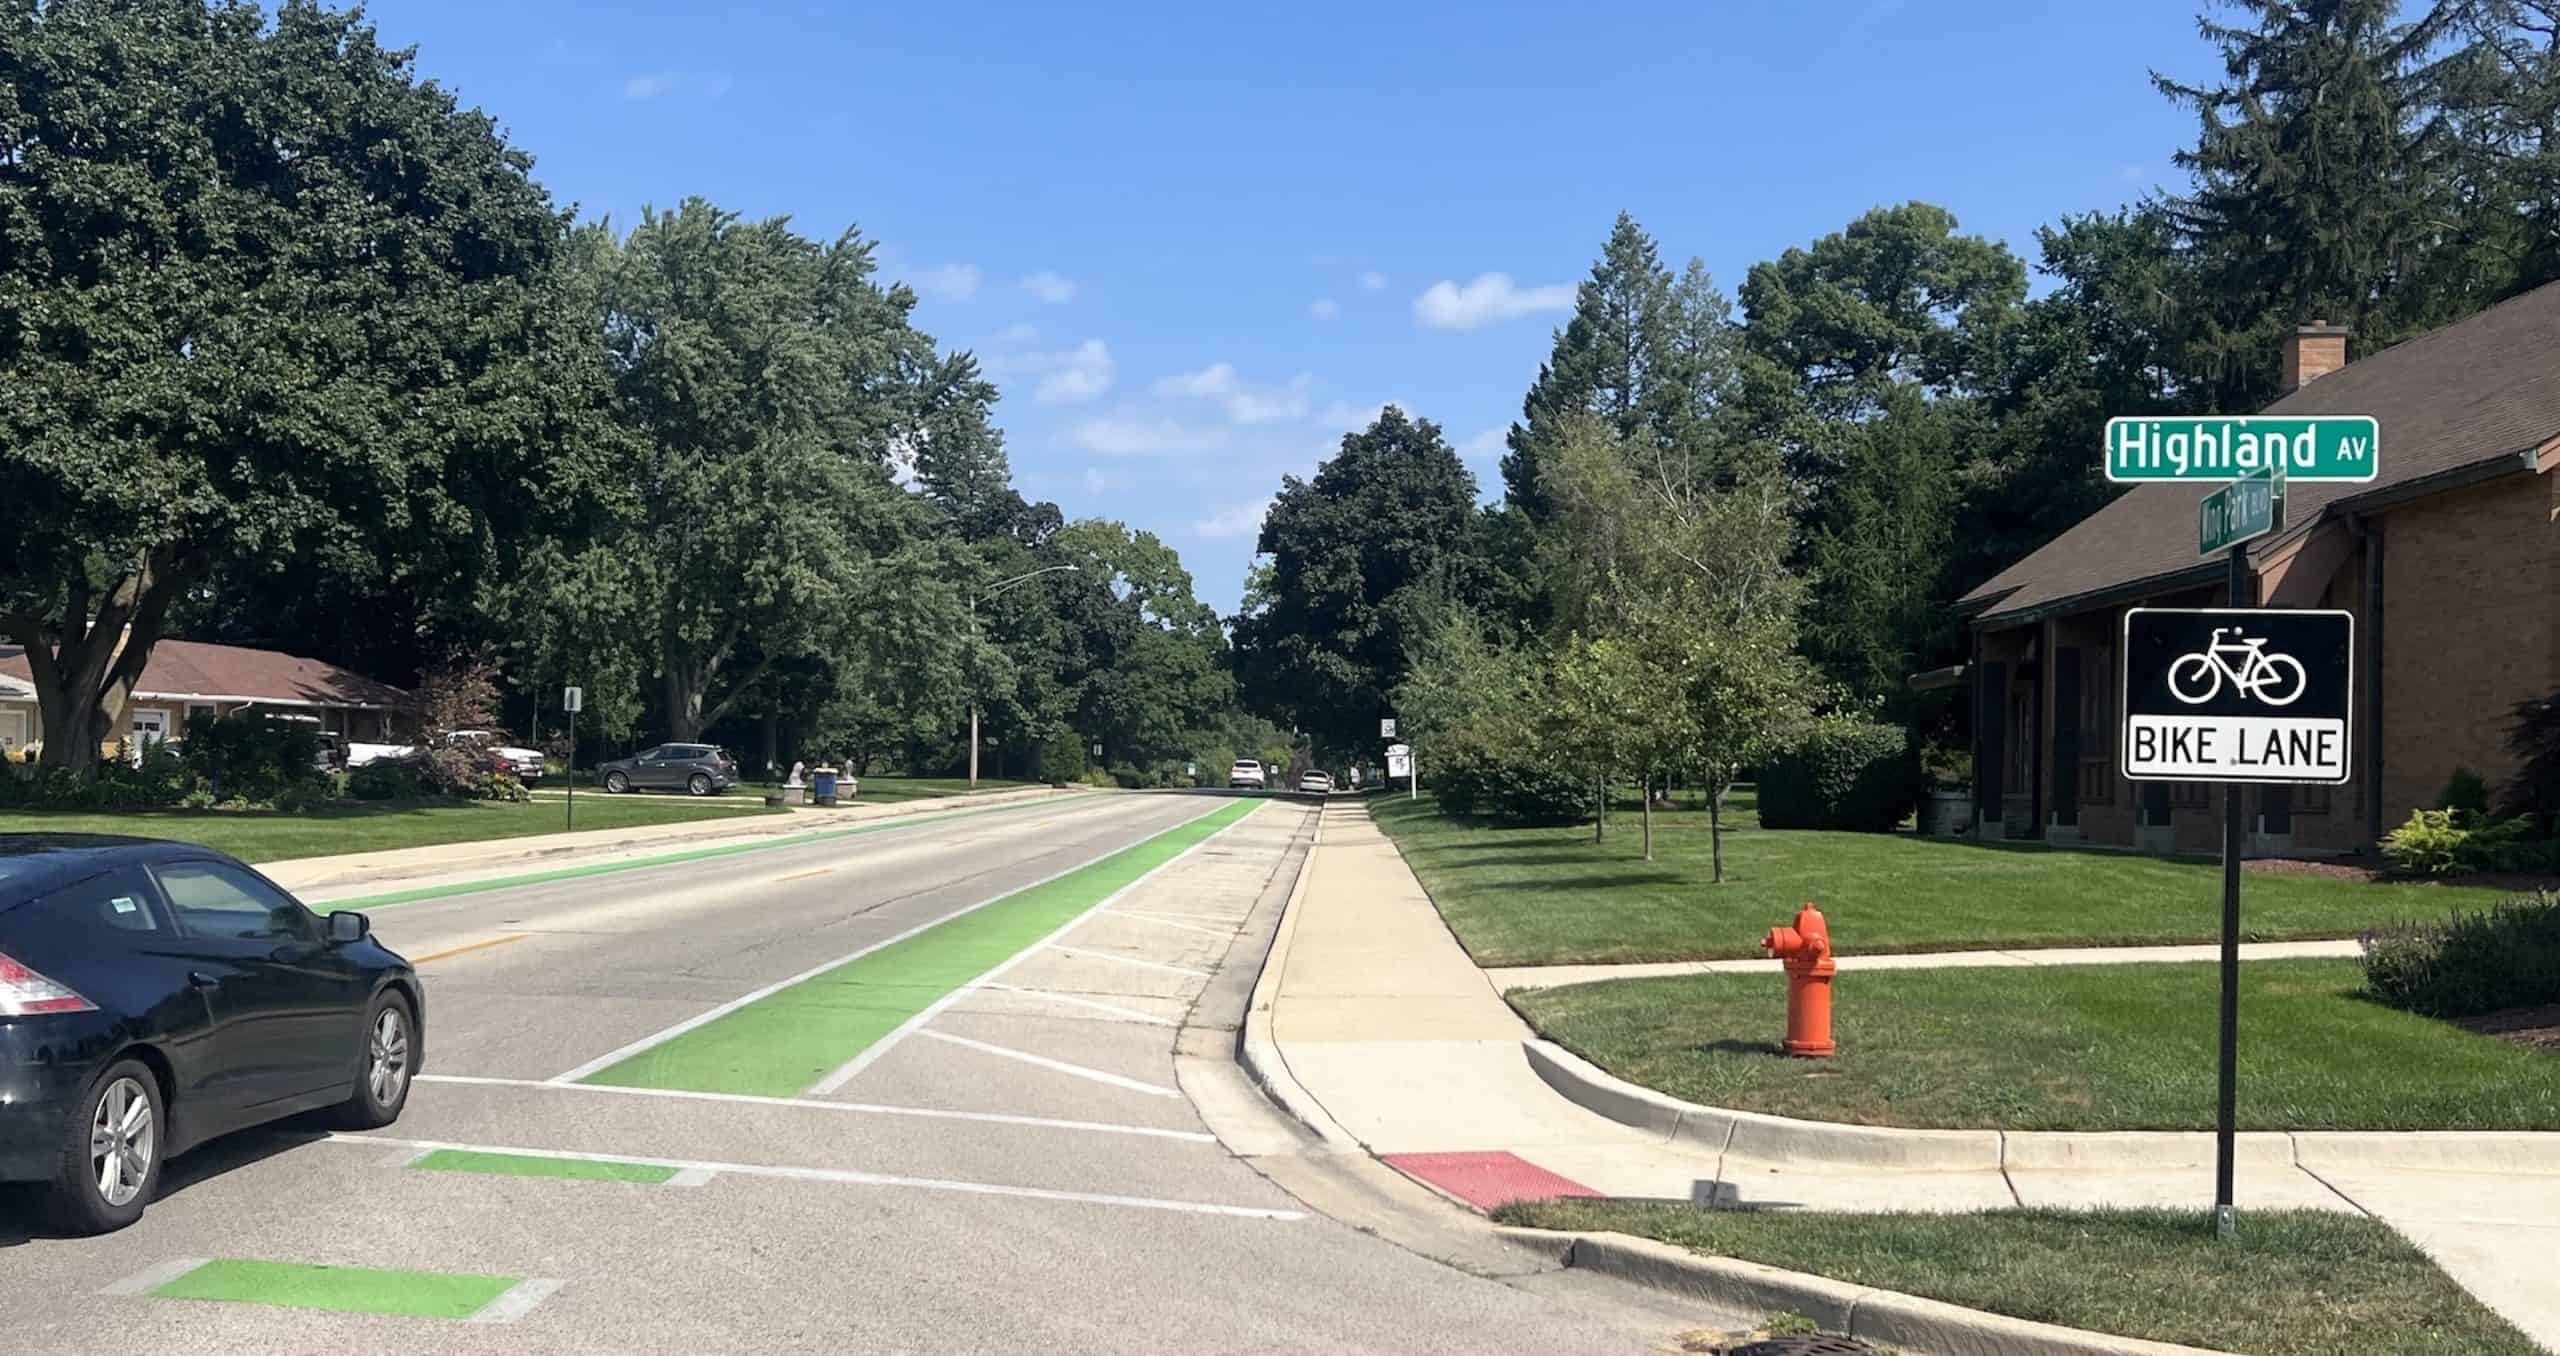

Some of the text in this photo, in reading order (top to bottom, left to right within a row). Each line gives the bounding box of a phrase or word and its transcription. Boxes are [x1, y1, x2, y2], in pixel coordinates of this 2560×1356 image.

[2119, 422, 2367, 475] Highland AV
[2224, 483, 2249, 535] Park
[2135, 726, 2338, 766] BIKE LANE
